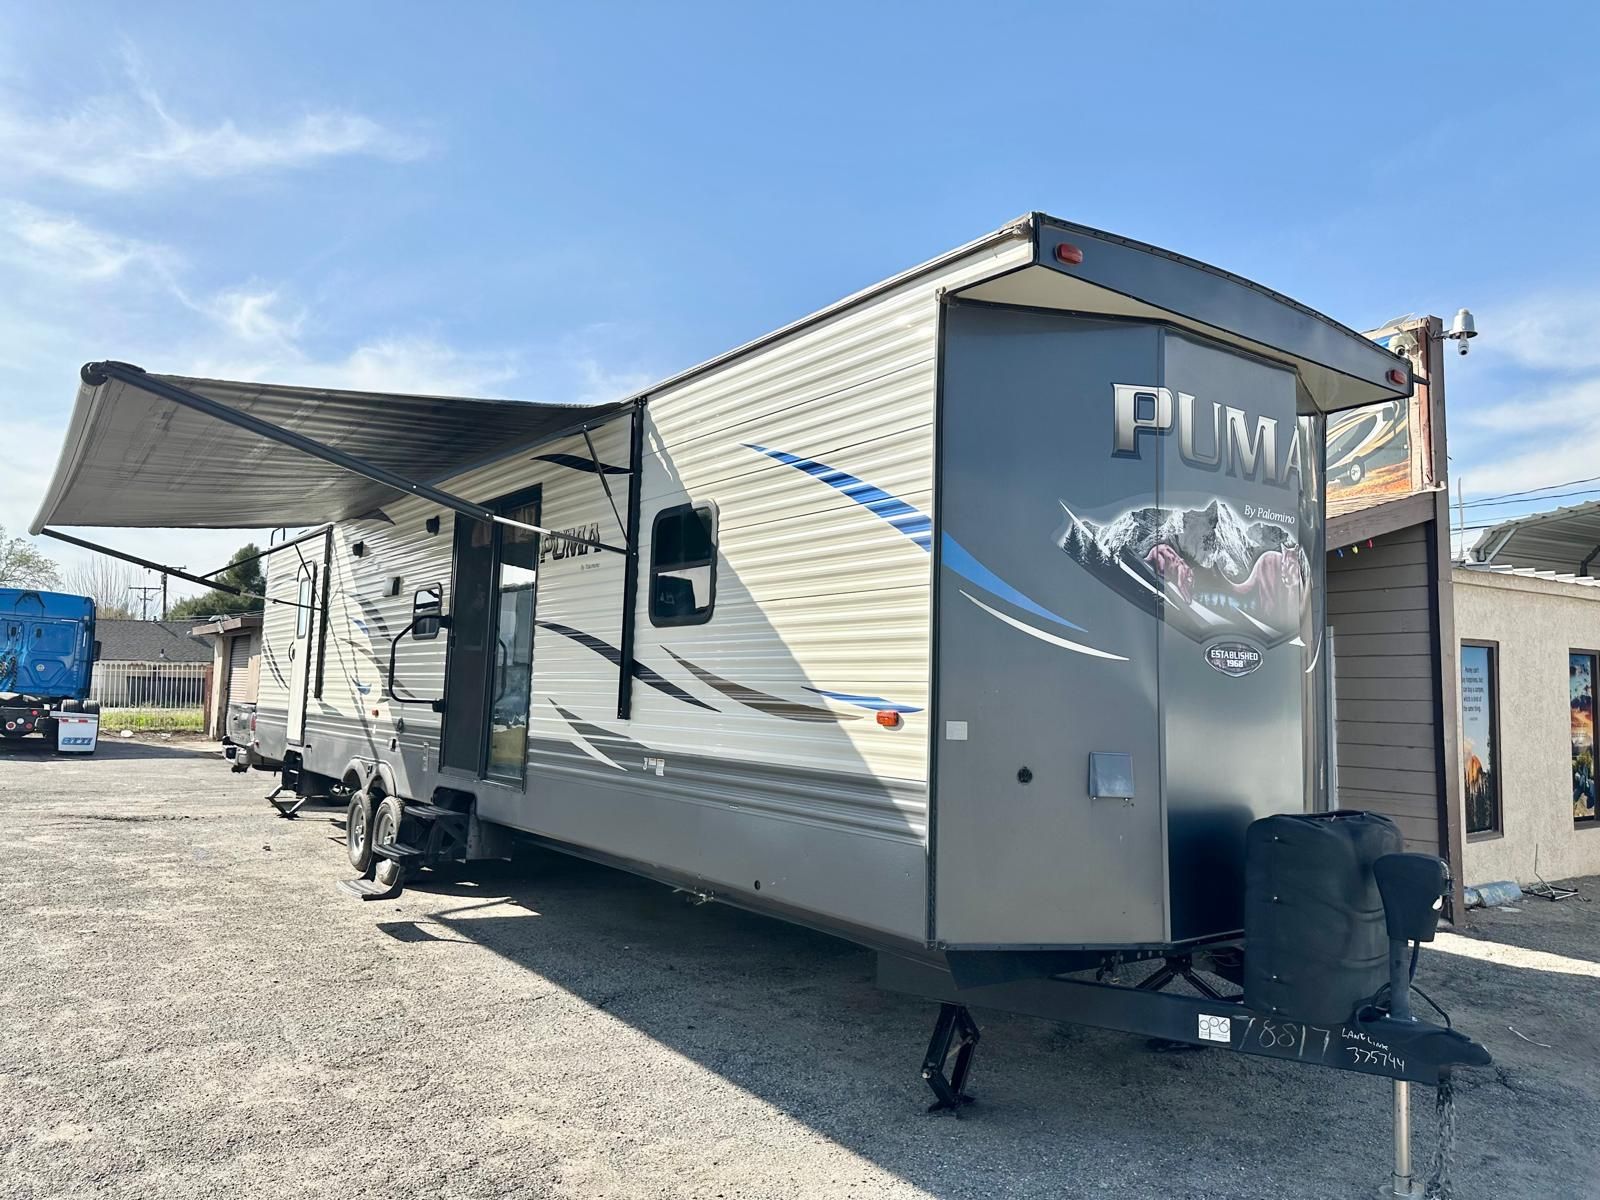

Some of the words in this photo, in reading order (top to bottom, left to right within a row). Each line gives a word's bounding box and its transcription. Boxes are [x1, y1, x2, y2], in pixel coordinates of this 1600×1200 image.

[1110, 383, 1304, 496] PUMA
[1244, 504, 1256, 519] By
[1257, 507, 1296, 525] Palomino
[1210, 649, 1259, 661] ESTABLISHED
[1232, 1015, 1331, 1057] 78817
[1345, 1046, 1405, 1072] 375744
